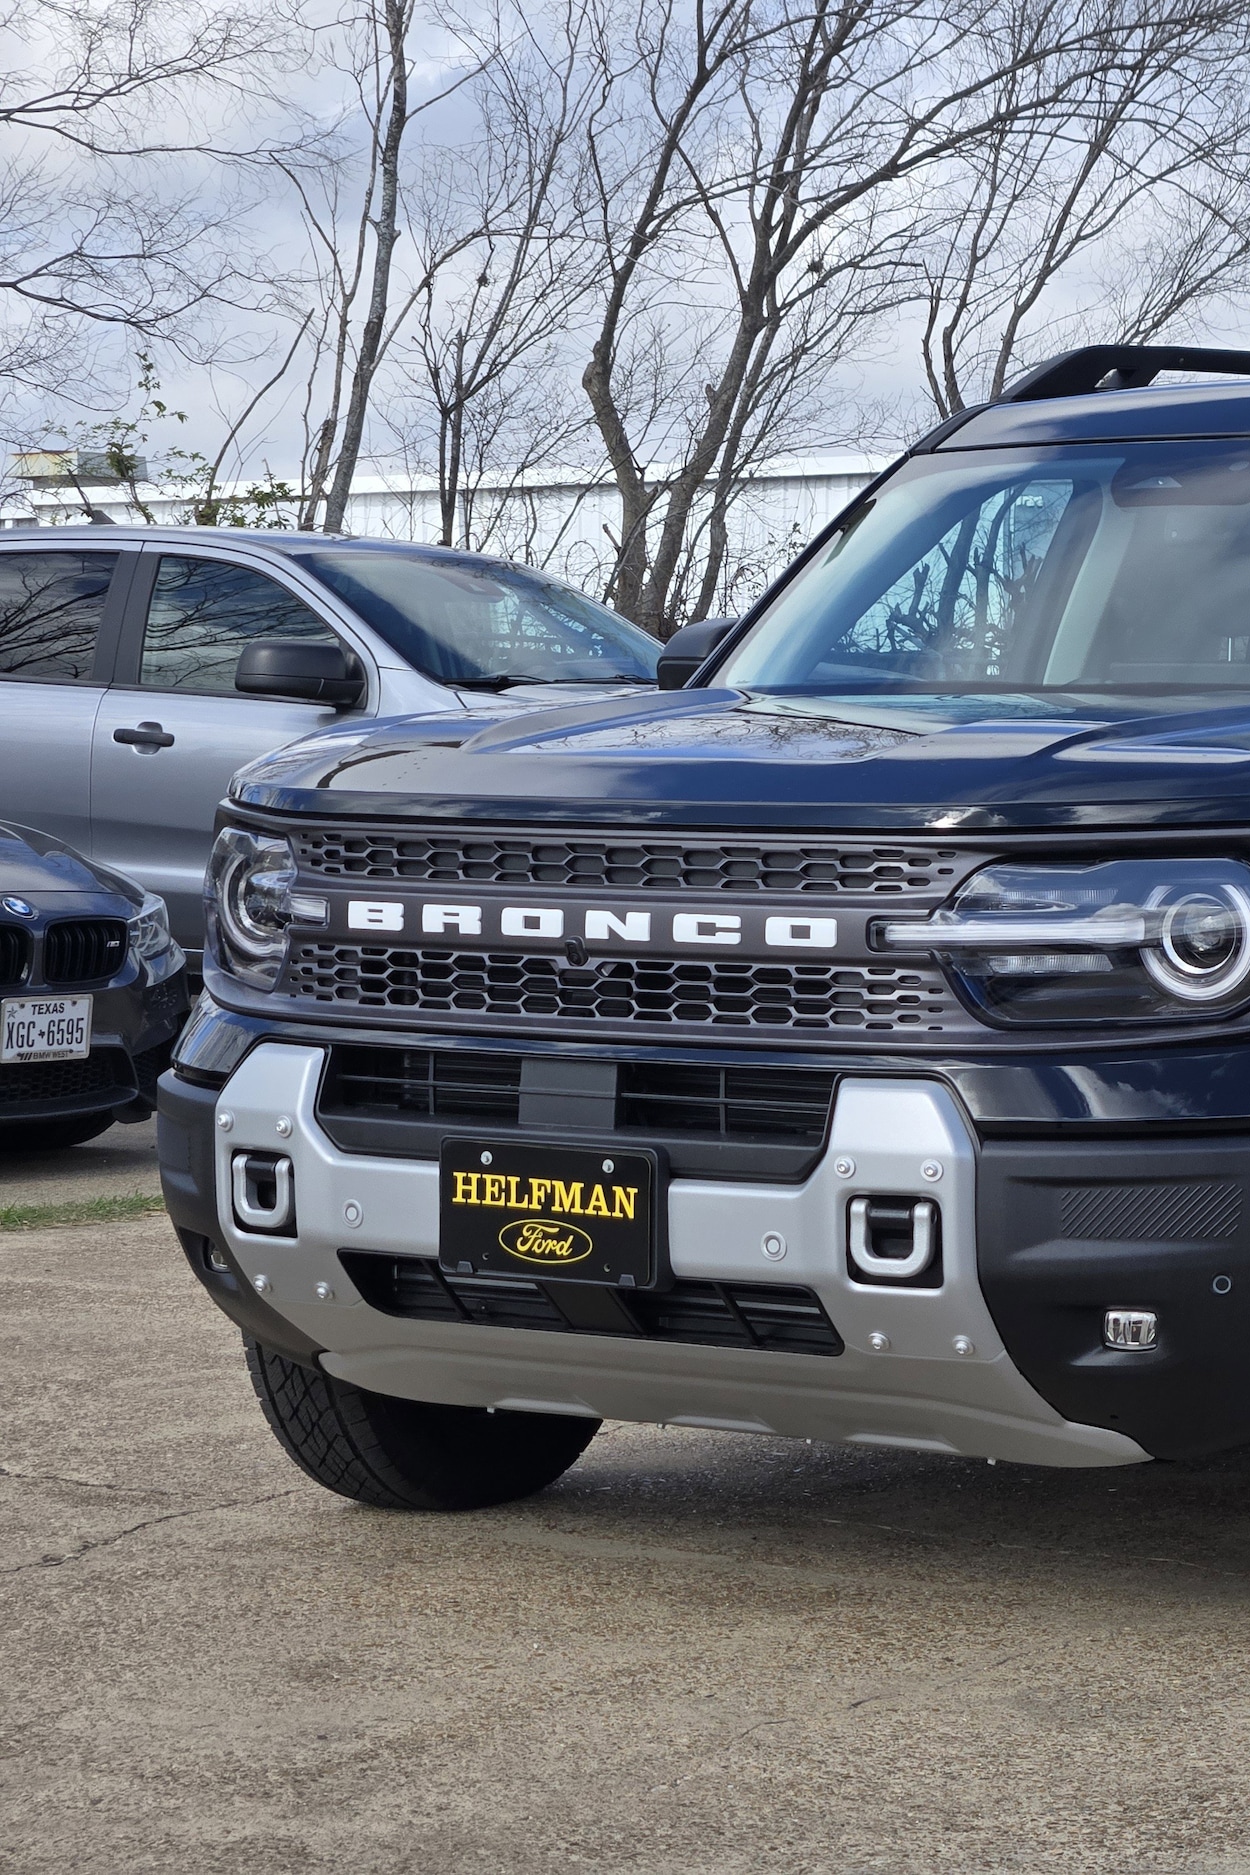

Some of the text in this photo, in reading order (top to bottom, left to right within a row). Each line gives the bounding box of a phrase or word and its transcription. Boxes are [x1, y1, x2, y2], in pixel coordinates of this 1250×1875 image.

[347, 900, 838, 948] BRONCO
[31, 1002, 65, 1015] TEXAS
[5, 1017, 84, 1049] XGC 6595
[33, 1050, 69, 1060] BMW WEST
[452, 1171, 638, 1220] HELFMAN
[516, 1223, 574, 1257] Ford
